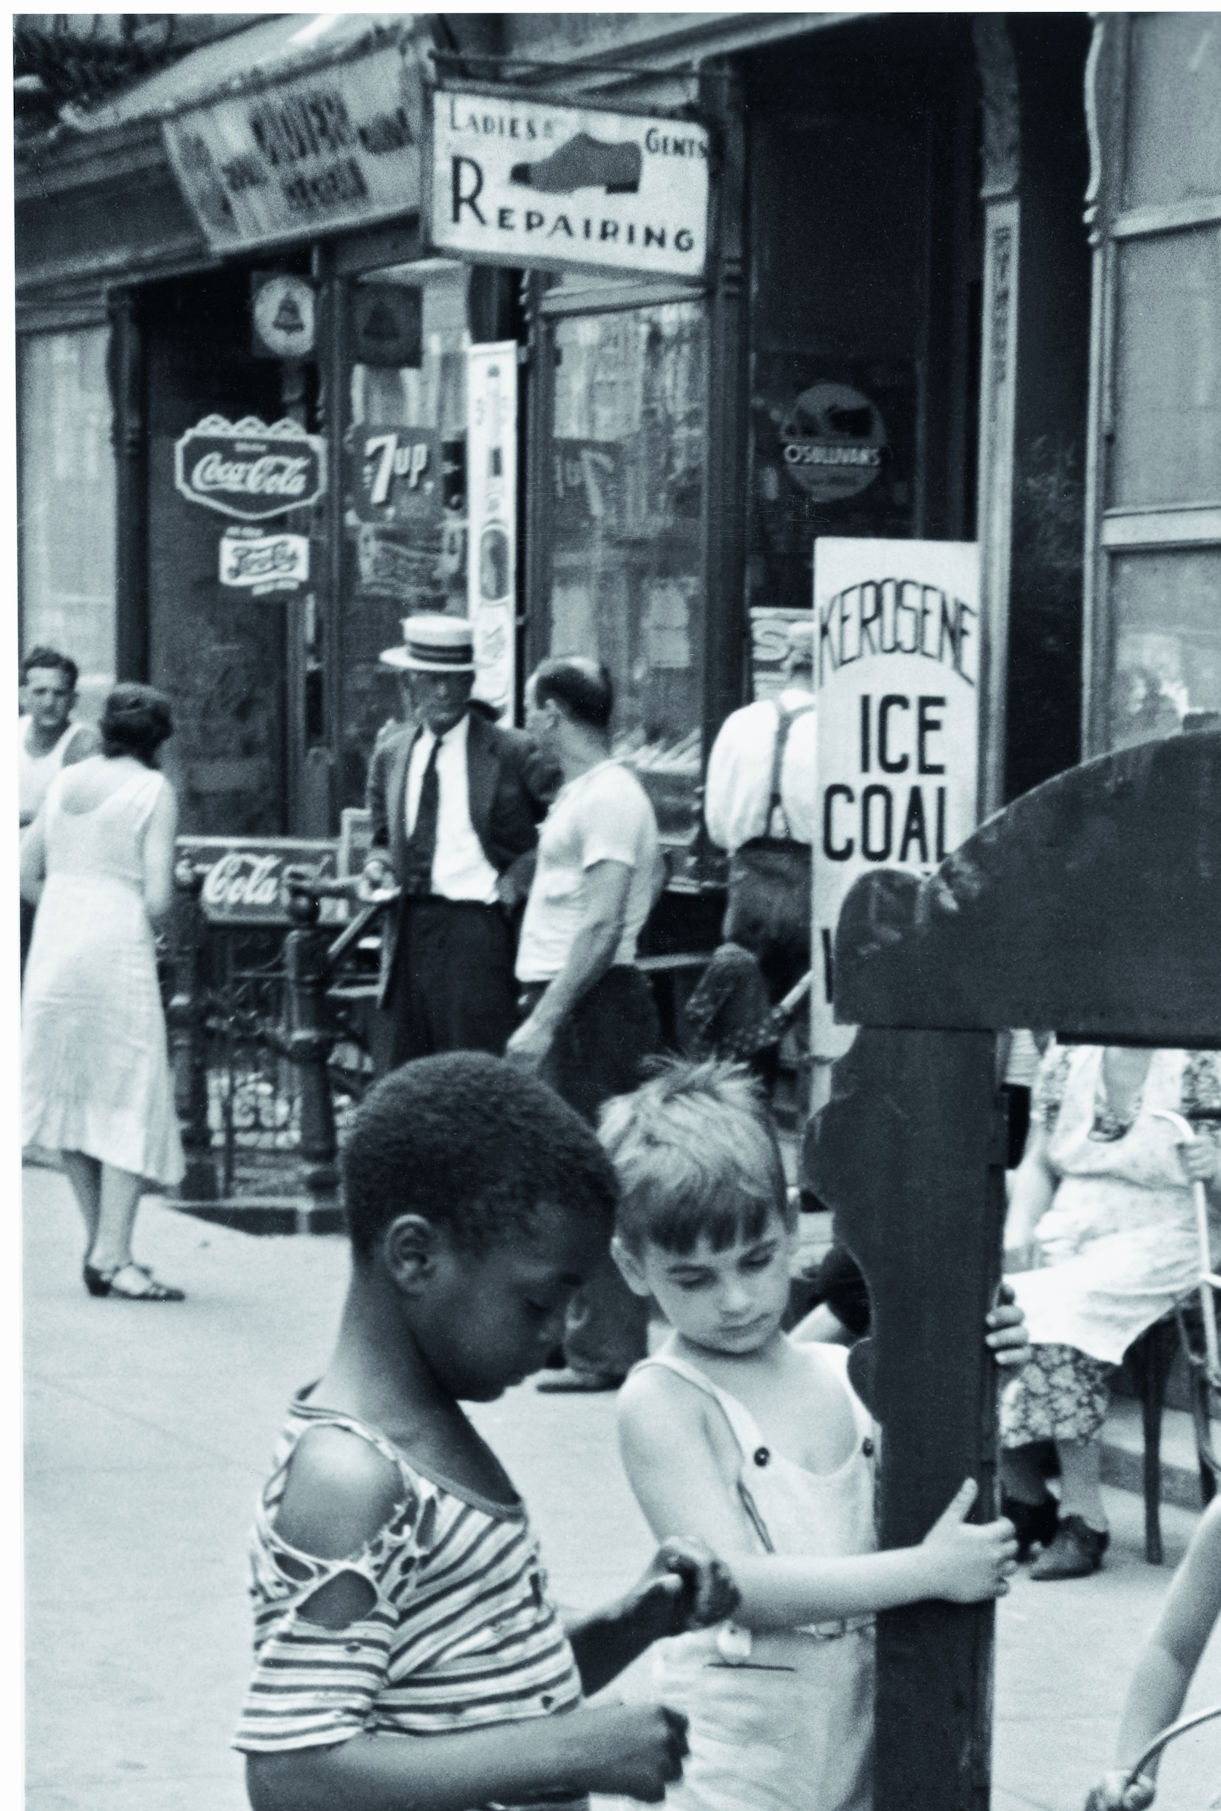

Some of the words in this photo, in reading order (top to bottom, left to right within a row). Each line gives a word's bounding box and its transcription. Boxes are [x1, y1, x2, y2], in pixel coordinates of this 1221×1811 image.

[450, 155, 695, 252] REPAIRING
[818, 577, 977, 690] KEROSENE
[859, 694, 947, 775] ICE
[822, 783, 952, 863] COAL
